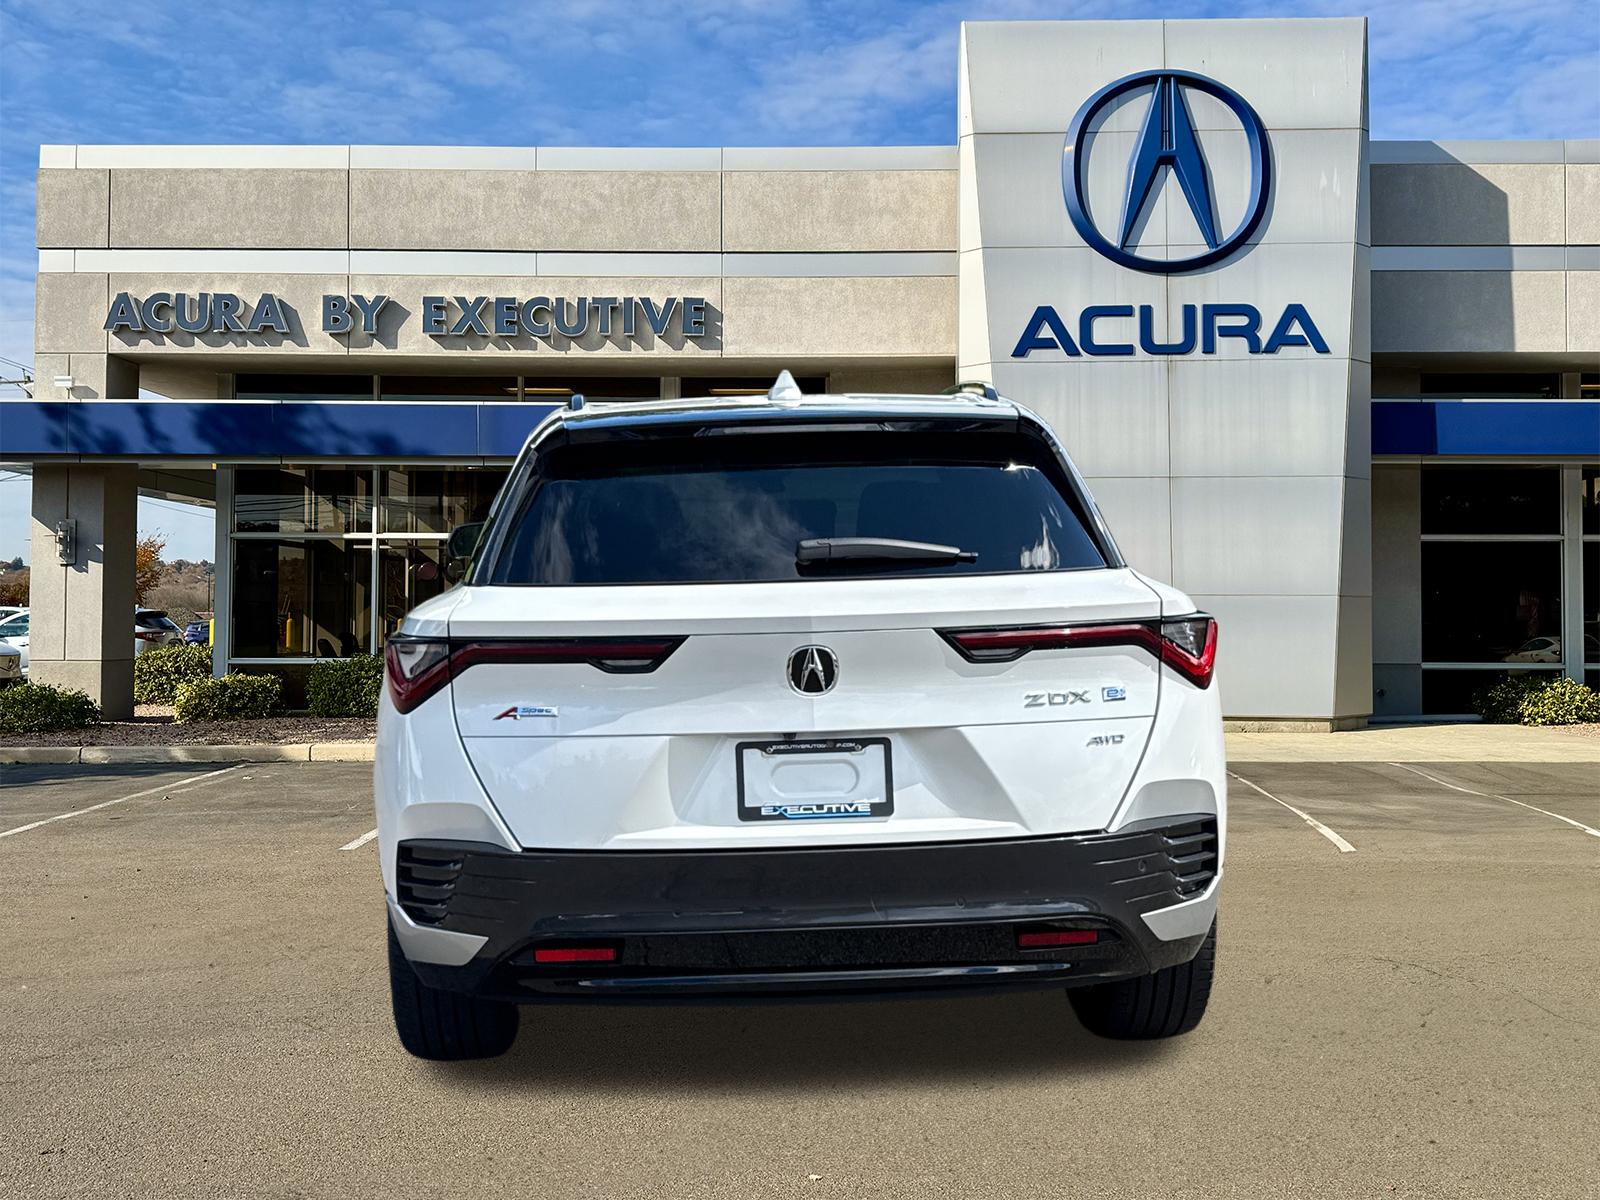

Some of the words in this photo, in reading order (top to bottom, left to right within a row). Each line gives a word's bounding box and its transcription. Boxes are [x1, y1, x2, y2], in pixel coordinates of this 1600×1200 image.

[104, 292, 290, 334] ACURA
[321, 294, 391, 335] BY
[422, 296, 709, 337] EXECUTIVE
[1011, 303, 1332, 358] ACURA
[1024, 690, 1091, 708] ZDX
[761, 803, 871, 816] EXECUTIVE
